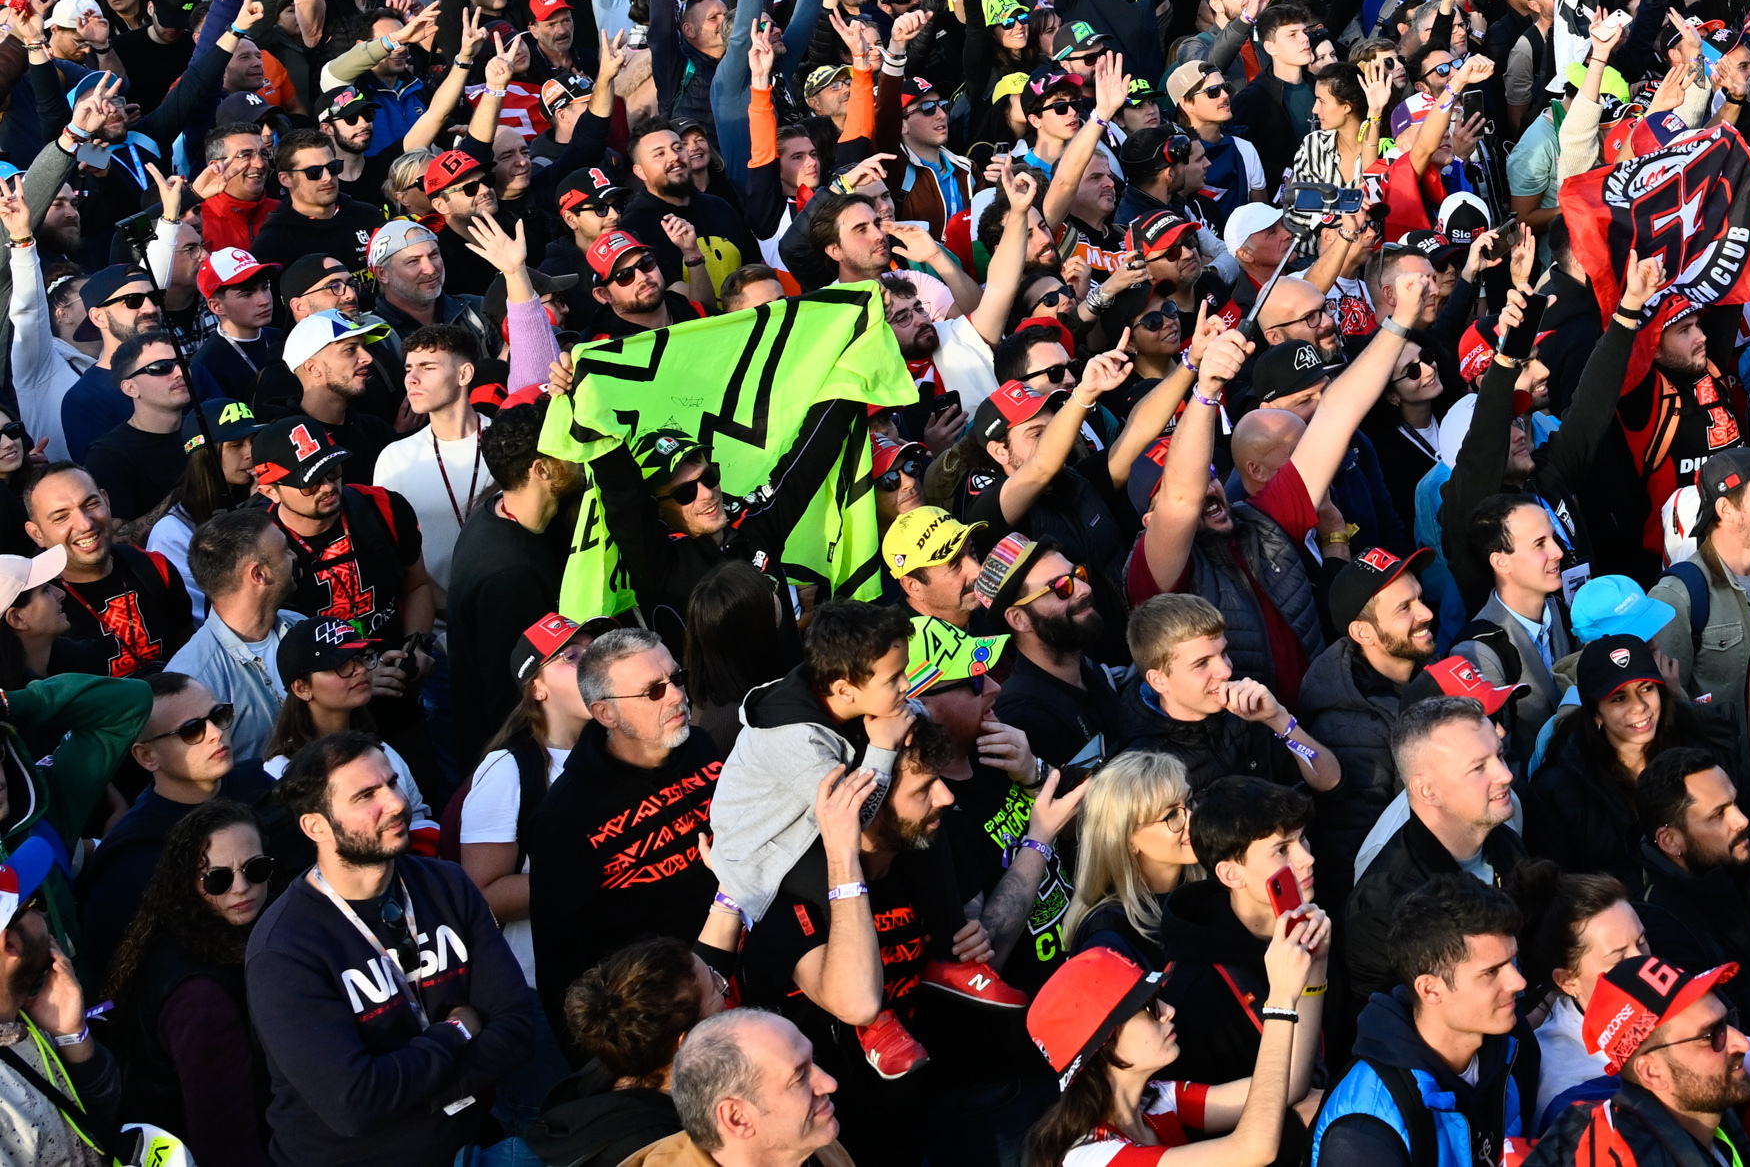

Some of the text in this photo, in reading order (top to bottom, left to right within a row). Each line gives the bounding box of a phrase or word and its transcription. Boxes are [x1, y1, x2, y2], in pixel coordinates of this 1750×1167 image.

[182, 3, 194, 11] 46
[912, 76, 933, 91] 1
[1128, 78, 1152, 94] 46
[334, 91, 354, 107] 72
[589, 168, 610, 188] 1
[1145, 214, 1179, 240] DUCATI
[1710, 226, 1750, 286] CLUB
[1294, 344, 1323, 370] 41
[217, 402, 255, 426] 46
[289, 423, 320, 462] 1
[341, 924, 469, 1014] NASA
[967, 973, 992, 991] N
